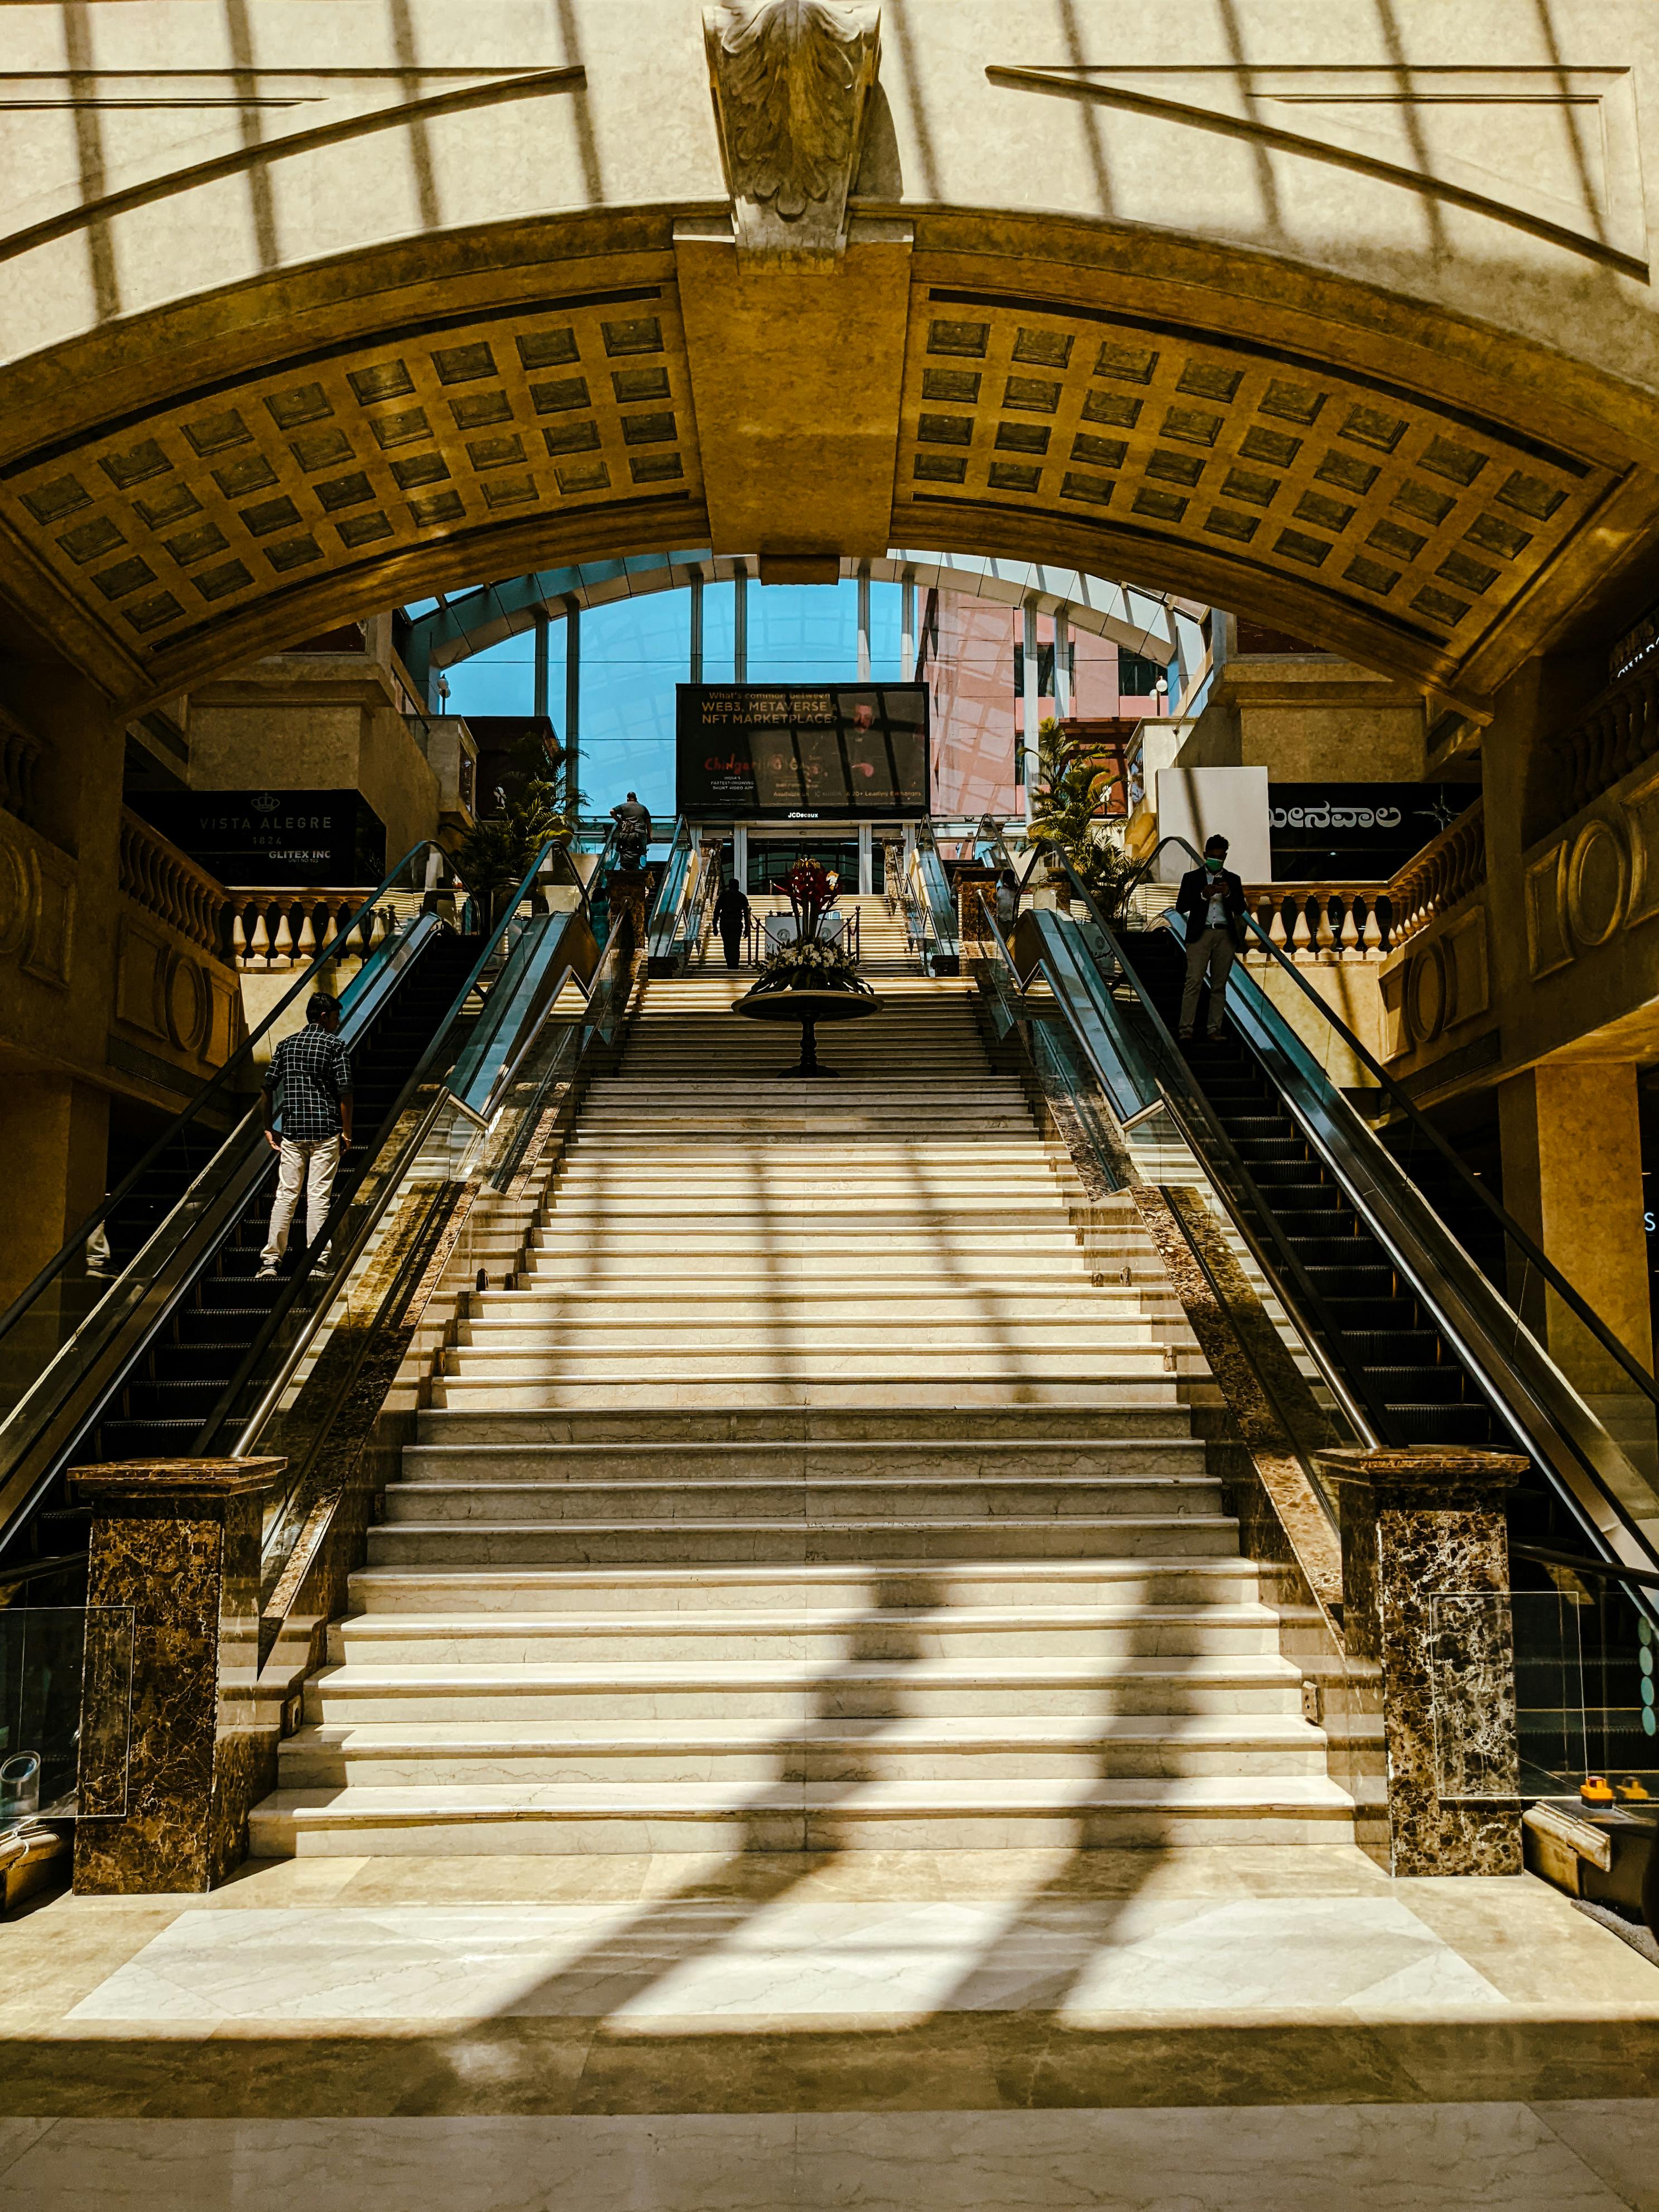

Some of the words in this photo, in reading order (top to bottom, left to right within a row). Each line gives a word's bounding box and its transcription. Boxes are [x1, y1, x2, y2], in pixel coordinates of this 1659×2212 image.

[749, 702, 827, 711] METAVERSE
[703, 714, 728, 724] NFT
[200, 817, 251, 829] VISTA
[261, 816, 331, 829] ALEGRE
[269, 850, 309, 859] GLITEX
[312, 850, 331, 859] INC
